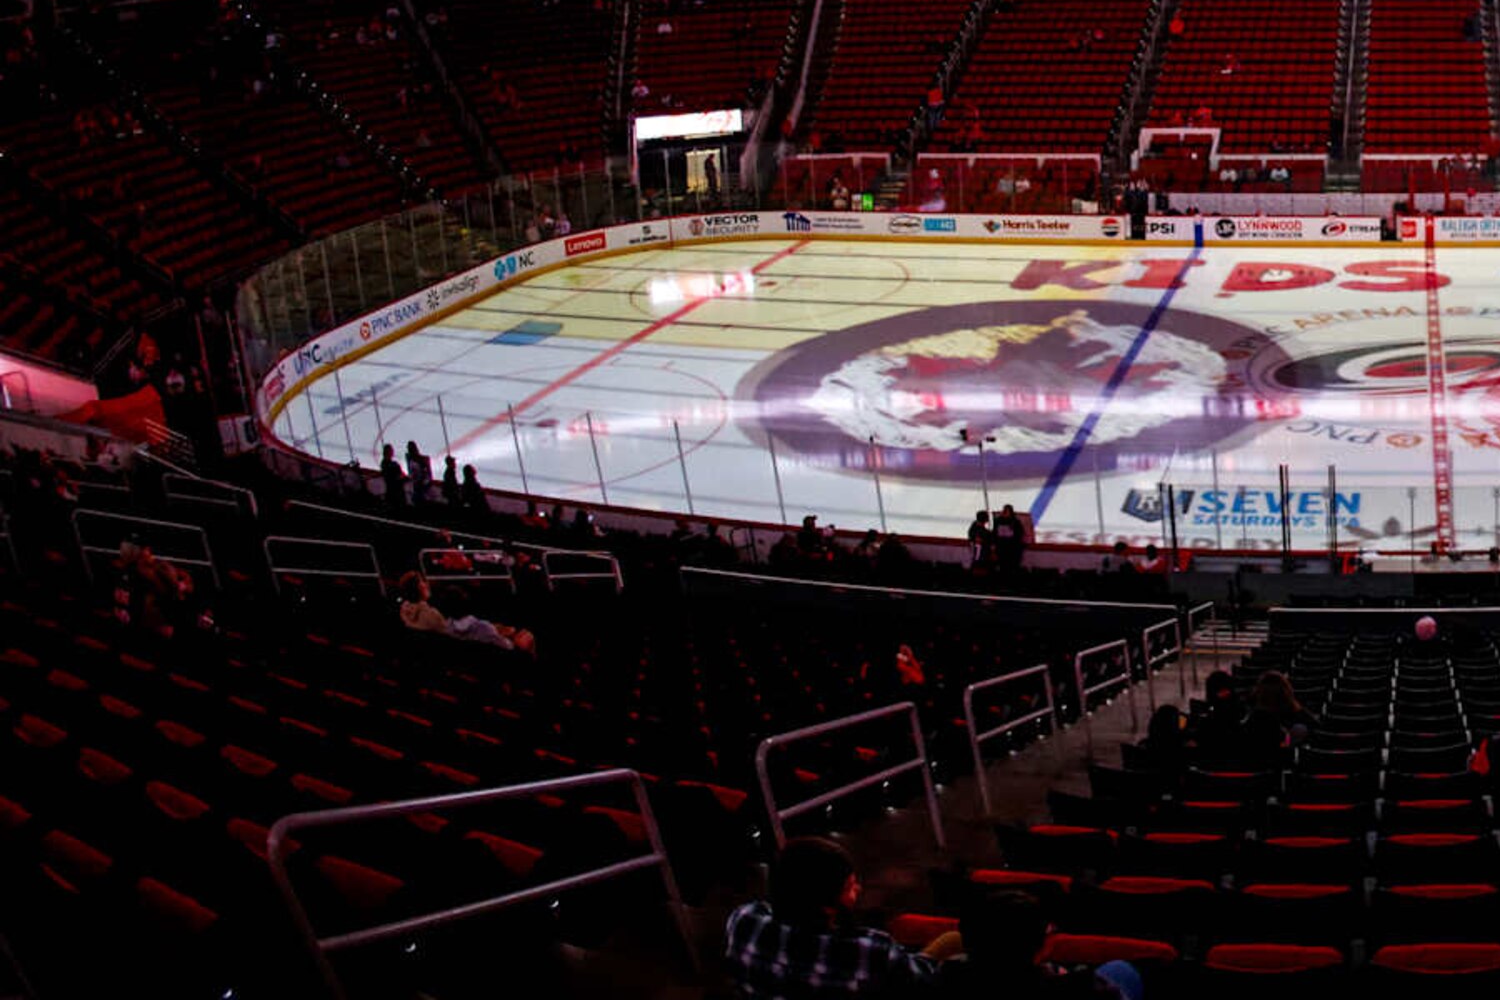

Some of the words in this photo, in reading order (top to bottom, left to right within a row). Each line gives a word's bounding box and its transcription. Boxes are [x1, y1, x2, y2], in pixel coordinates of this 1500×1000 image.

[705, 215, 759, 226] VECTOR
[1002, 219, 1035, 230] Harris
[1036, 220, 1071, 231] Teeter
[1238, 220, 1302, 231] LYNNWOOD
[706, 225, 759, 236] SECURITY
[568, 237, 603, 252] Lenovo
[518, 251, 536, 269] NC
[1010, 258, 1452, 298] KIDS
[371, 314, 393, 334] PNC
[395, 302, 421, 322] BANK
[1197, 489, 1361, 514] SEVEN
[1193, 514, 1317, 528] SATURDAYS
